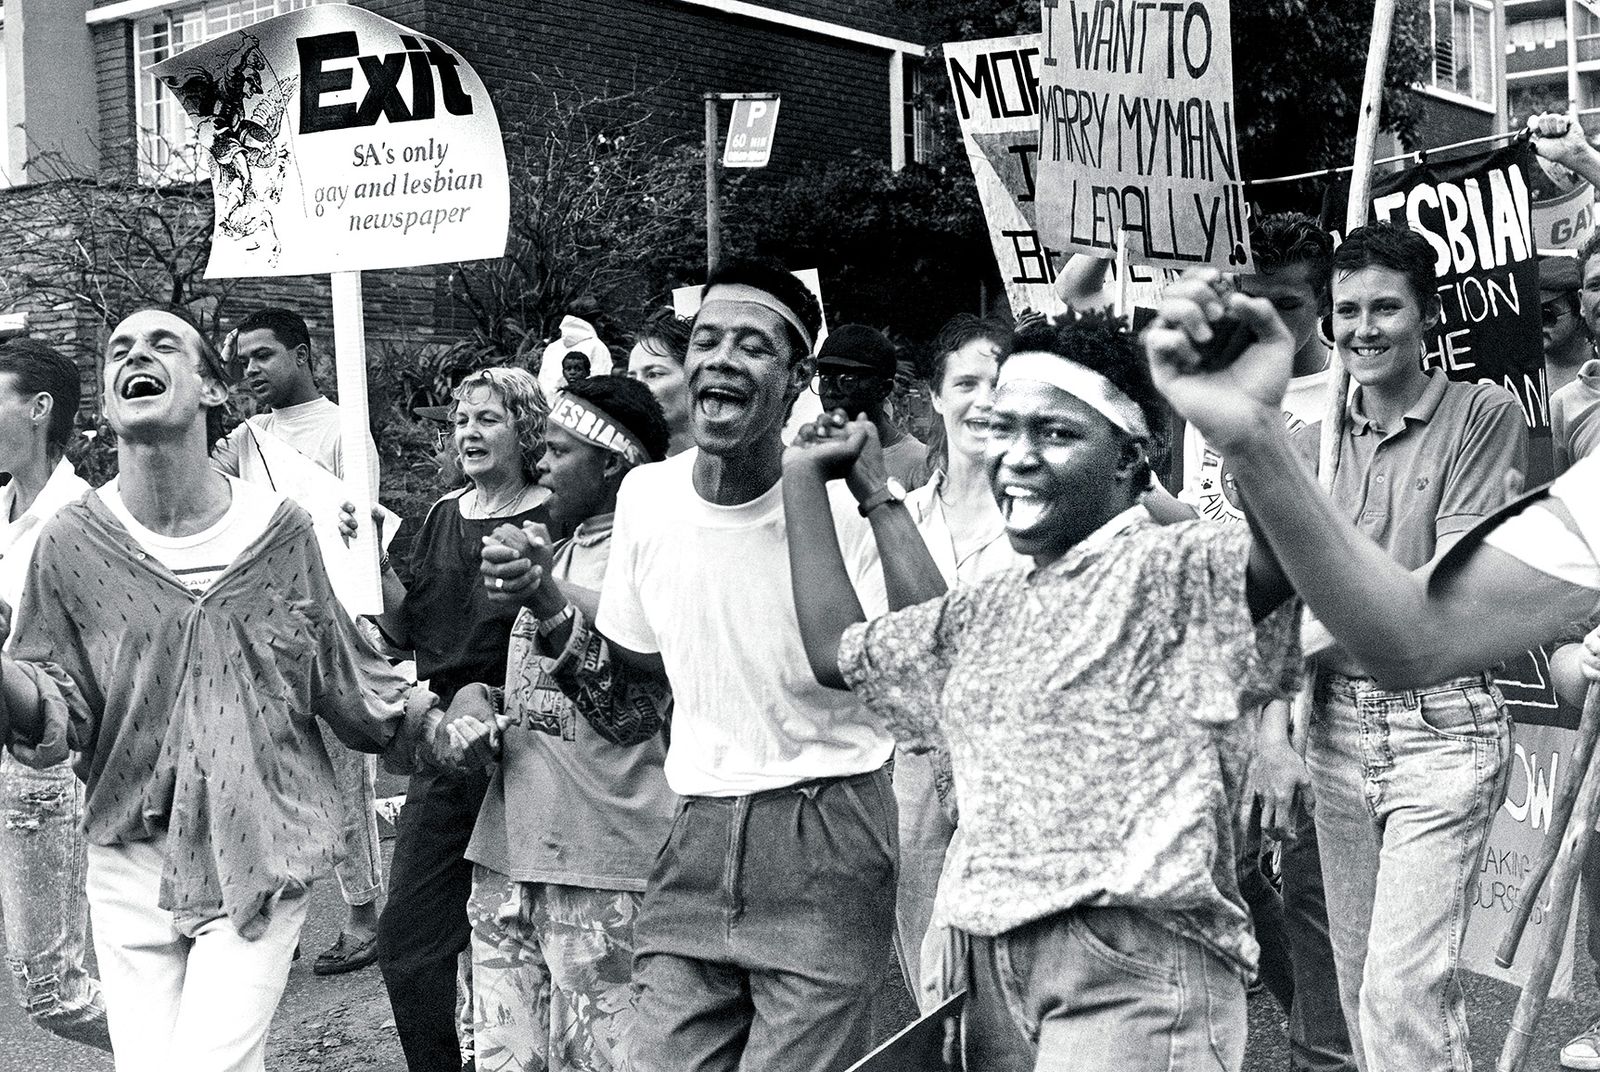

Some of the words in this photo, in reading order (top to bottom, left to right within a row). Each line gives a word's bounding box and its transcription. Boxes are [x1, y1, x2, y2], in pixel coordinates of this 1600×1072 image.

[1044, 3, 1057, 66] I
[1071, 0, 1156, 74] WANT
[1160, 2, 1212, 79] TO
[296, 31, 473, 134] Exit
[747, 101, 768, 127] P
[1039, 85, 1109, 168] MARRY
[353, 142, 396, 167] SA's
[403, 138, 448, 168] only
[732, 133, 747, 148] 60
[315, 184, 348, 217] gay
[354, 174, 396, 198] and
[403, 169, 483, 195] lesbian
[349, 207, 471, 235] newspaper
